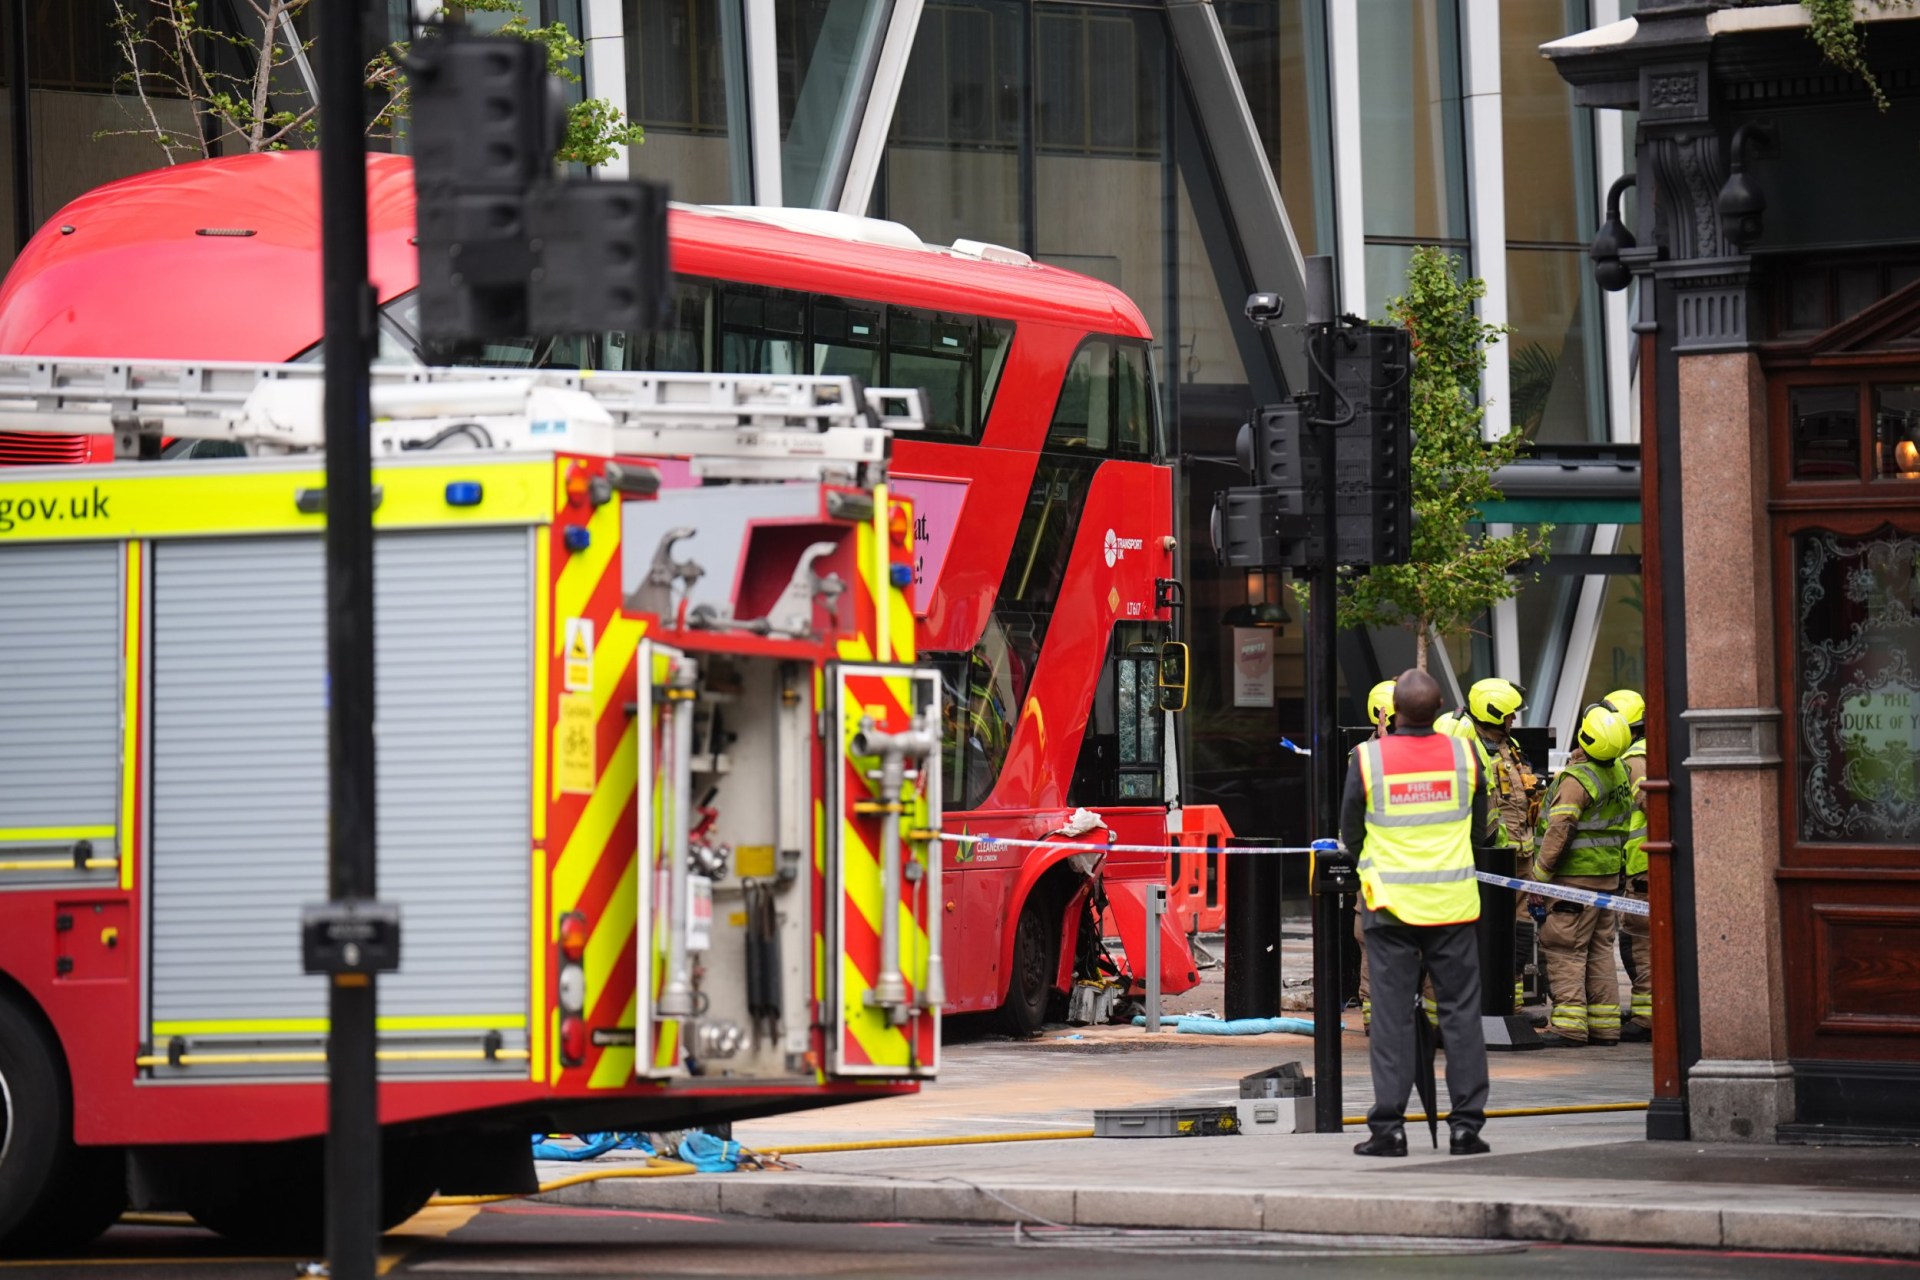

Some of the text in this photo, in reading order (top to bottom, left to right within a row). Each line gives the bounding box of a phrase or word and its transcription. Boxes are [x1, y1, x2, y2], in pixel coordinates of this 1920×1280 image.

[0, 486, 110, 532] gov.uk
[1117, 538, 1143, 550] TRANSPORT
[1117, 549, 1125, 560] UK
[1881, 692, 1911, 708] THE
[1843, 712, 1920, 731] DUKE OF Y
[1407, 782, 1434, 793] FIRE
[1606, 780, 1632, 807] FIRE
[1391, 790, 1450, 804] MARSHAL
